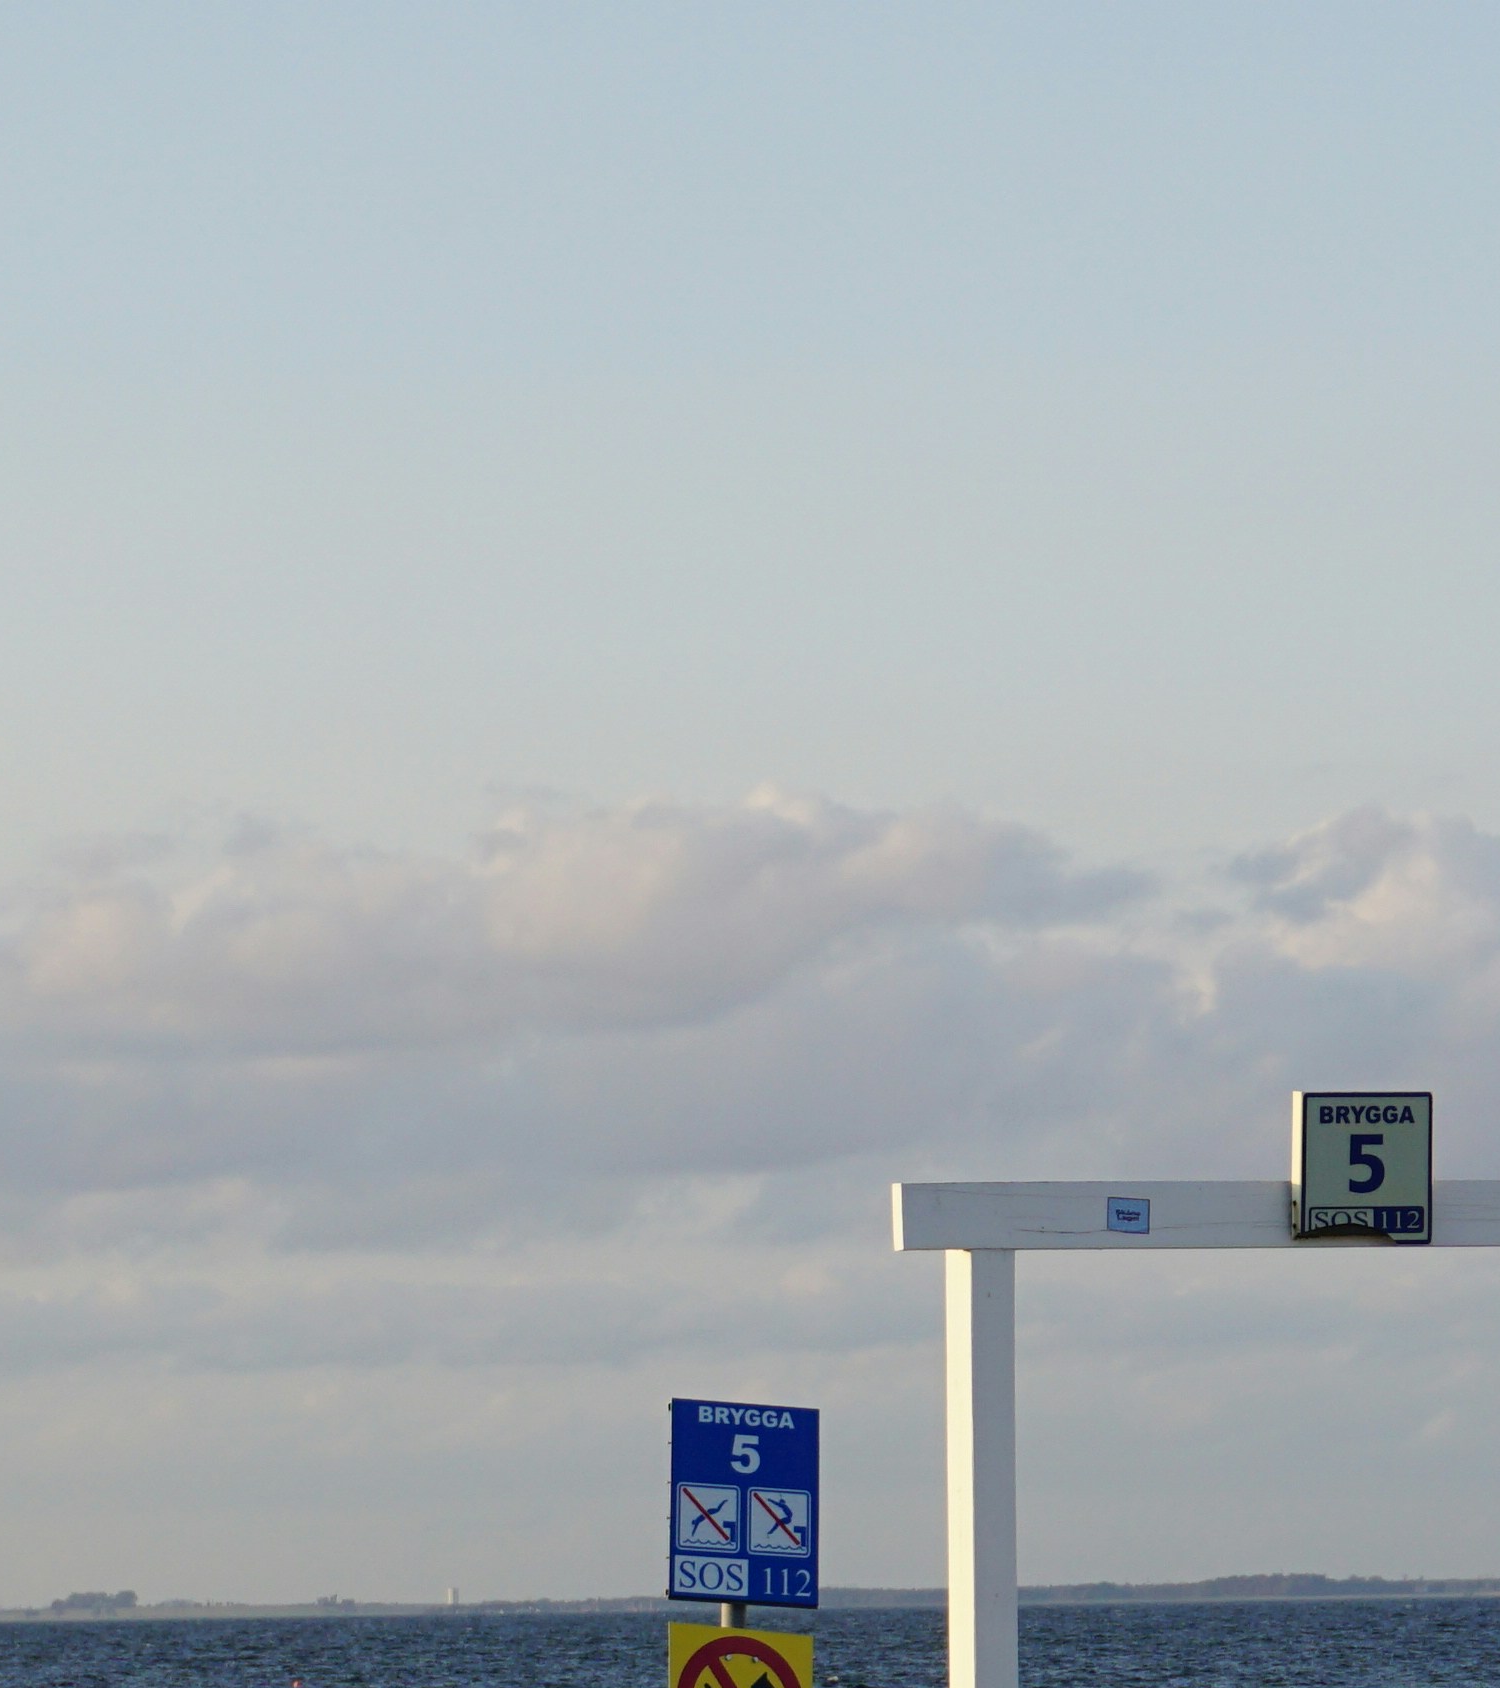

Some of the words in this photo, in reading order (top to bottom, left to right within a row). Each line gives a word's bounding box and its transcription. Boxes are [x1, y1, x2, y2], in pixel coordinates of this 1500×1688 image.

[1319, 1105, 1415, 1124] BRYGGA
[1349, 1133, 1385, 1194] 5
[1381, 1210, 1420, 1229] 112
[698, 1405, 795, 1429] BRYGGA
[730, 1433, 761, 1474] 5
[679, 1560, 744, 1591] SOS
[763, 1567, 812, 1597] 112
